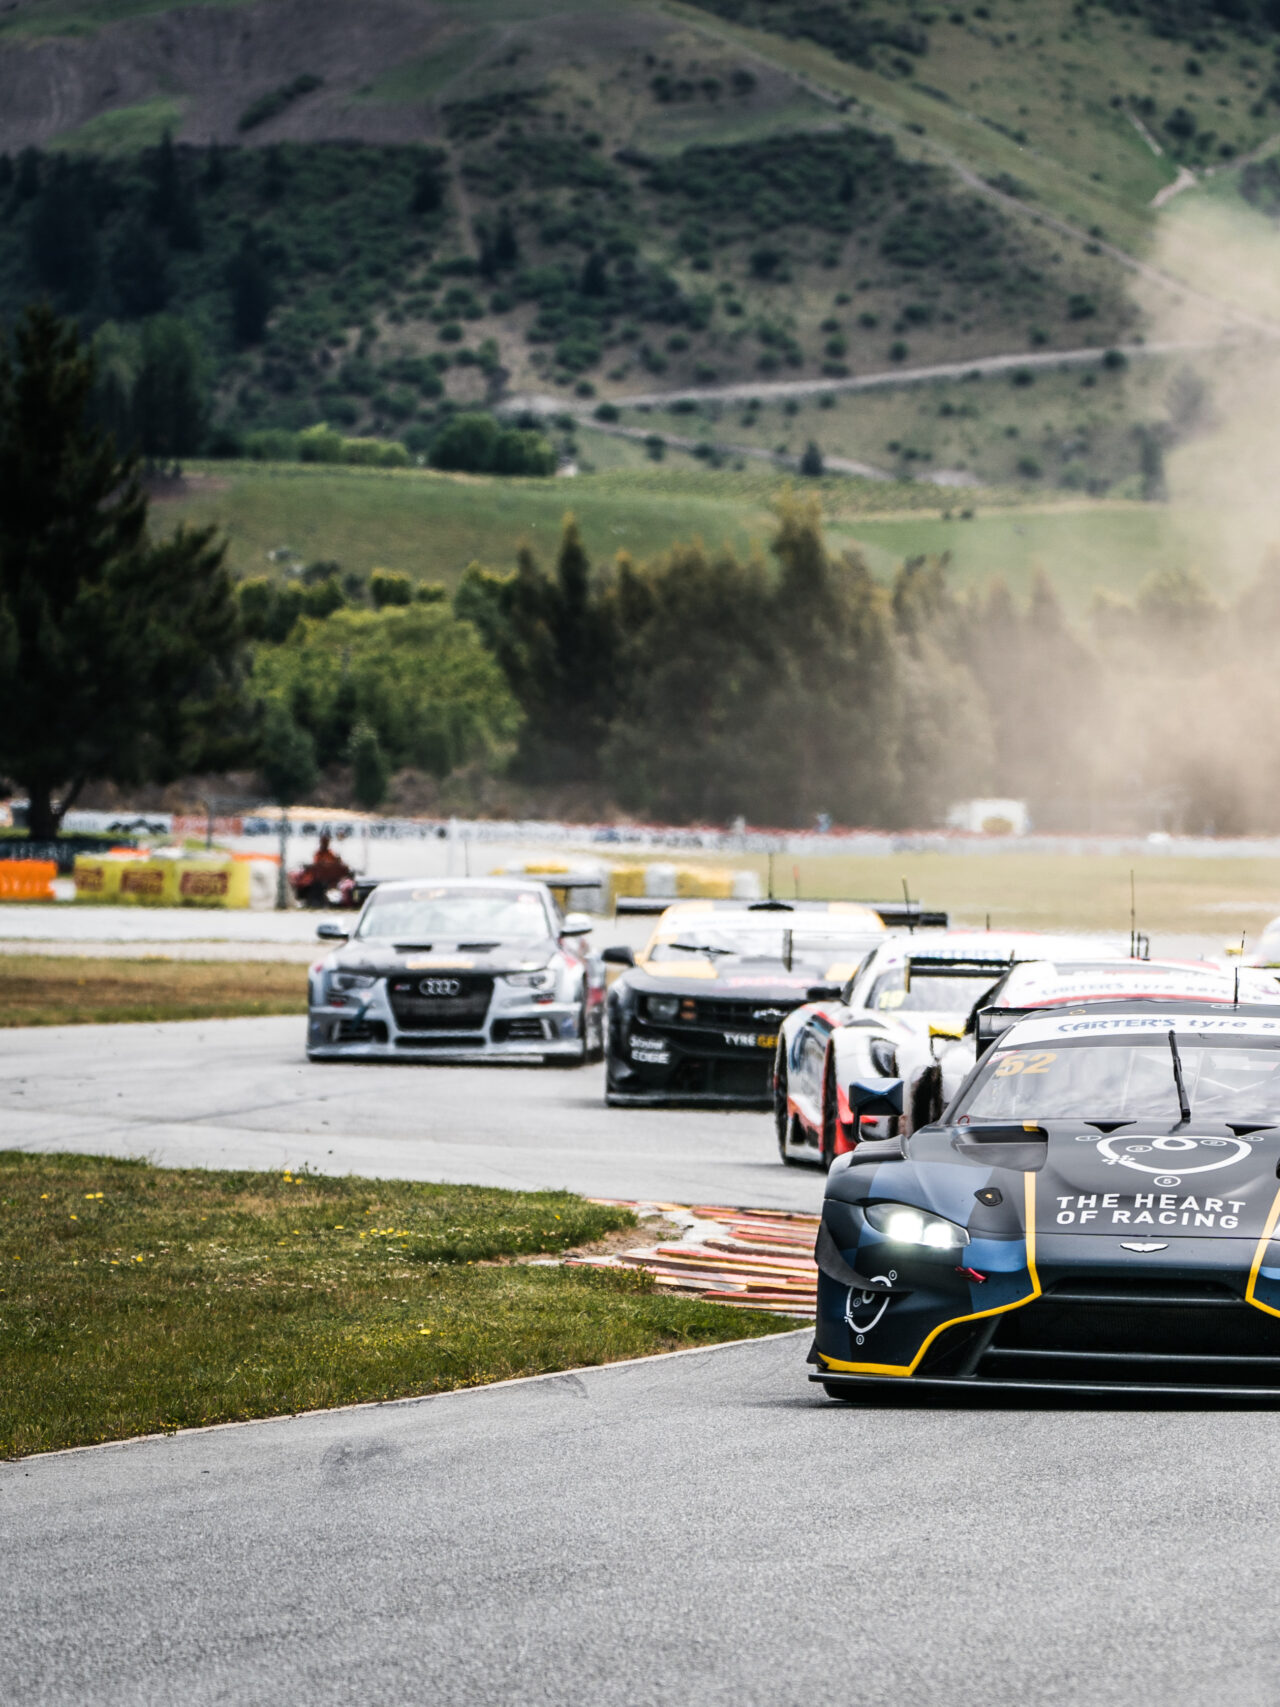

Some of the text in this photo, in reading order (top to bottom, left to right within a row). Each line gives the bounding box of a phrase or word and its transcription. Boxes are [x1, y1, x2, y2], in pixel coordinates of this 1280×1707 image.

[1185, 985, 1263, 1001] servce
[1058, 1018, 1176, 1032] CARTER'S
[1188, 1018, 1248, 1028] tyre
[723, 1031, 779, 1048] TYRE GE
[631, 1049, 670, 1065] EDGE
[995, 1052, 1057, 1078] 52
[1056, 1193, 1247, 1214] THE HEART
[1056, 1210, 1240, 1229] OF RACING
